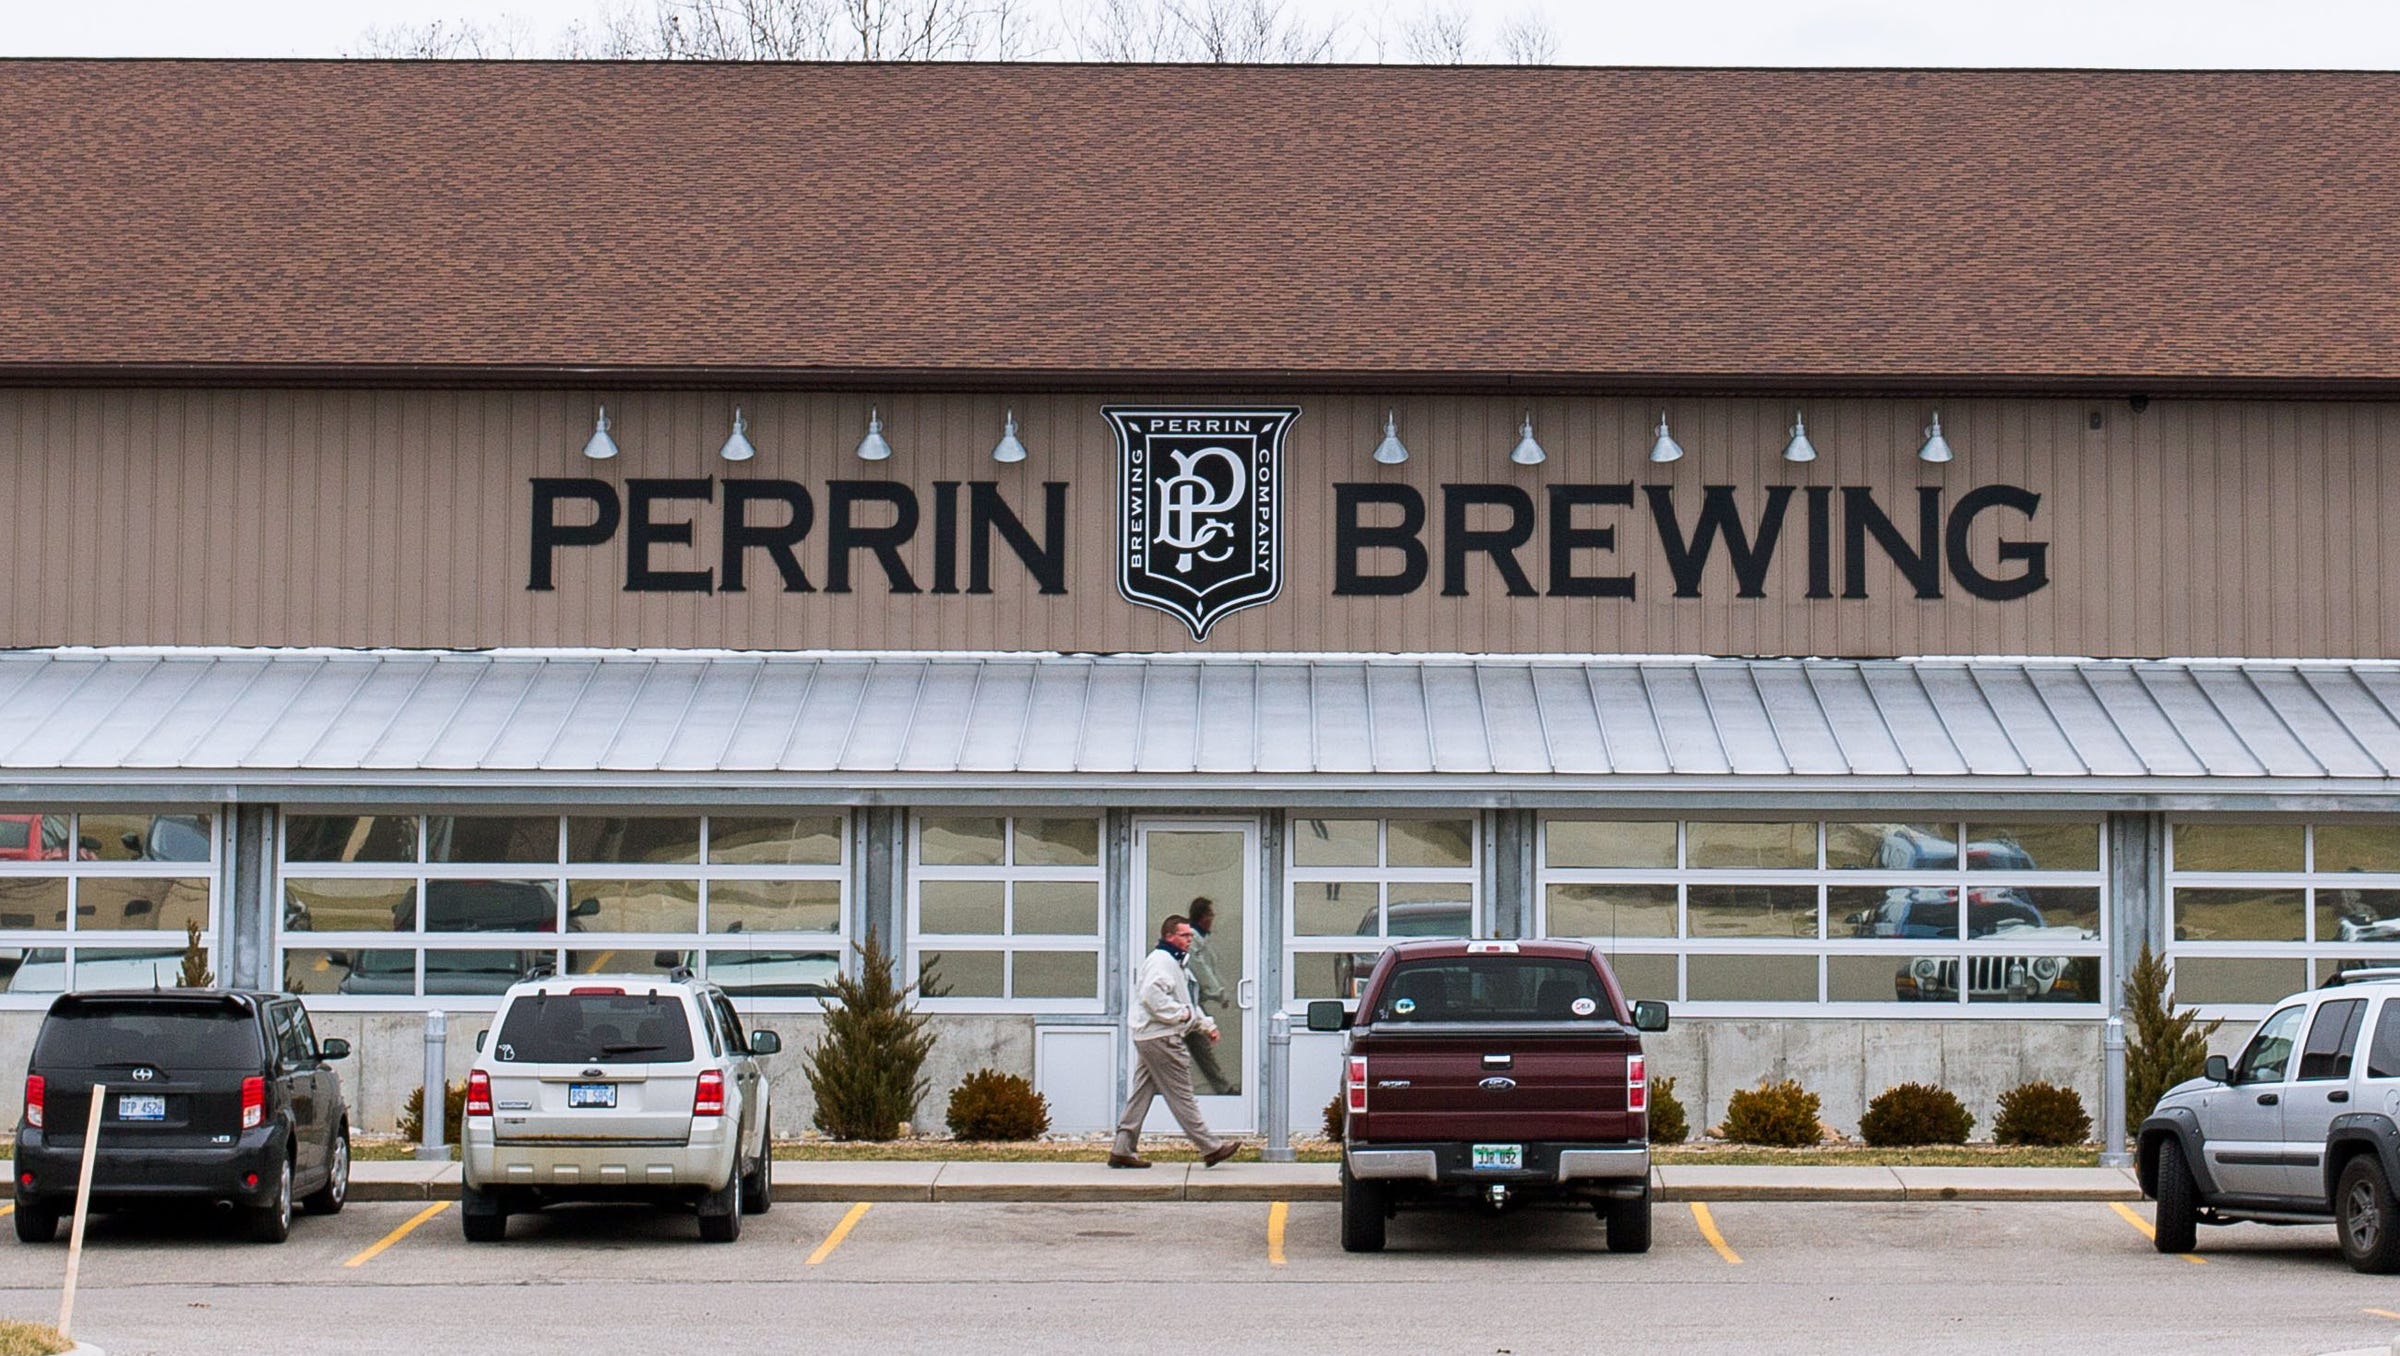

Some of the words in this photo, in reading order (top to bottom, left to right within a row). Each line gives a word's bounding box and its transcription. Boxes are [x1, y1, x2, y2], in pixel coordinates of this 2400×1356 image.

[1150, 419, 1251, 432] PERRIN
[525, 474, 1070, 596] PERRIN
[1332, 480, 2049, 602] BREWING
[1131, 449, 1143, 568] BREWING
[1258, 449, 1270, 572] COMPANY
